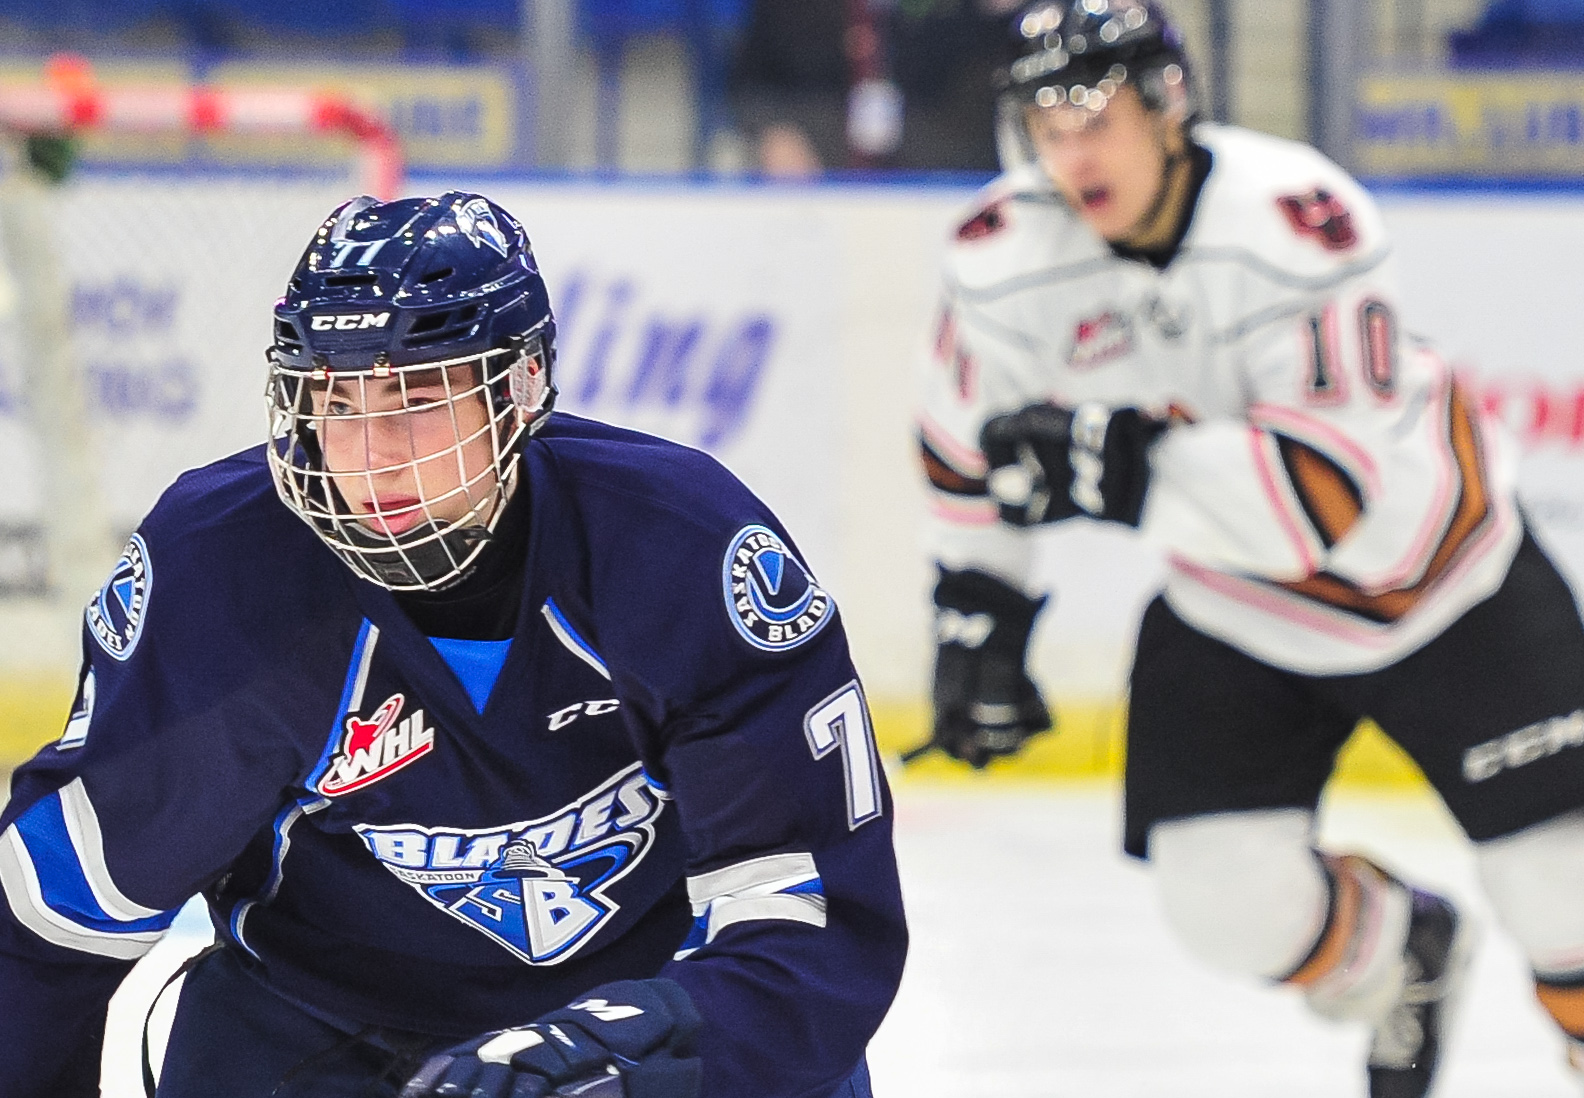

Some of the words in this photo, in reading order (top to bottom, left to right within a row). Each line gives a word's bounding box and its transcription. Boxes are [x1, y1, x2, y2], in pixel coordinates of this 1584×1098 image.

[310, 311, 391, 331] CCM
[1300, 298, 1400, 404] 10
[331, 708, 435, 784] WHL
[546, 698, 621, 731] CC
[366, 774, 654, 870] BLADES
